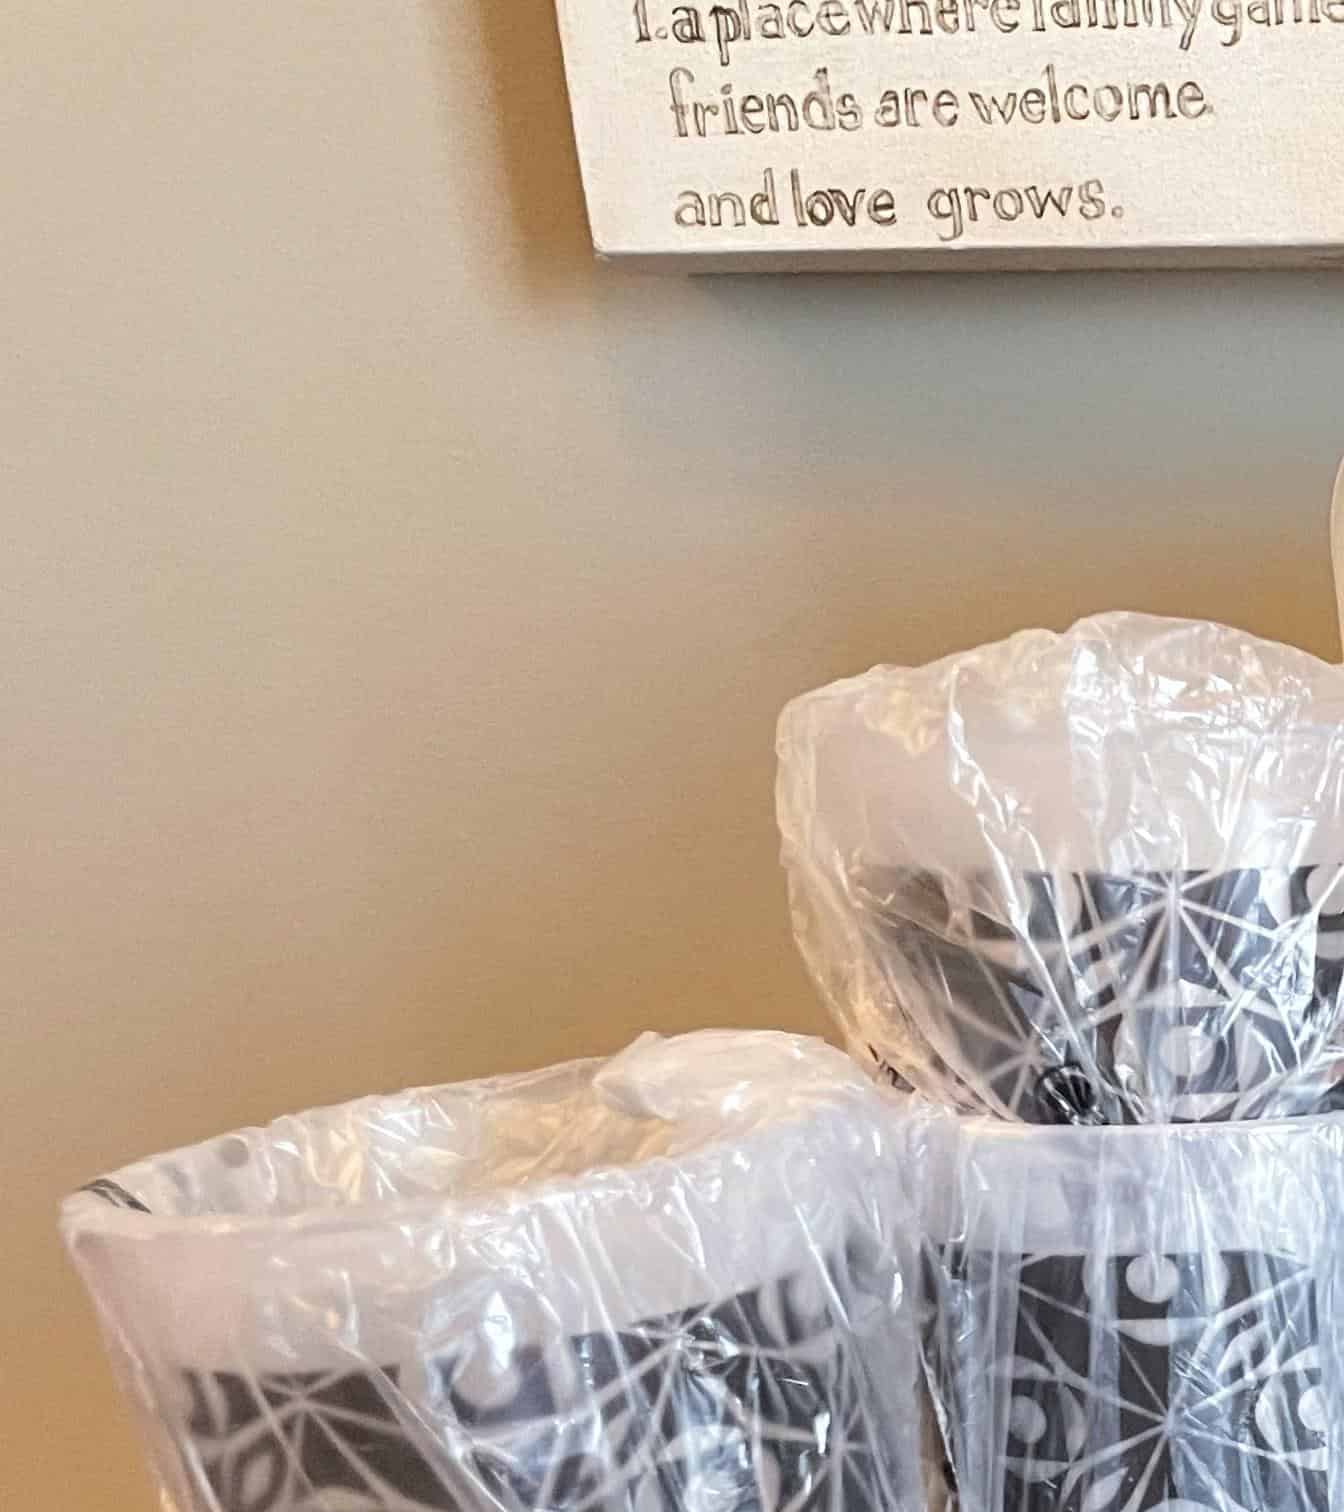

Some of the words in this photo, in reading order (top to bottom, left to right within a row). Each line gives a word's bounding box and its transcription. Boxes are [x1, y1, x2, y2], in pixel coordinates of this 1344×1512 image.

[668, 66, 864, 138] friends
[873, 84, 961, 129] are
[673, 167, 780, 228] and
[790, 167, 899, 228] love
[926, 178, 1126, 242] grows.
